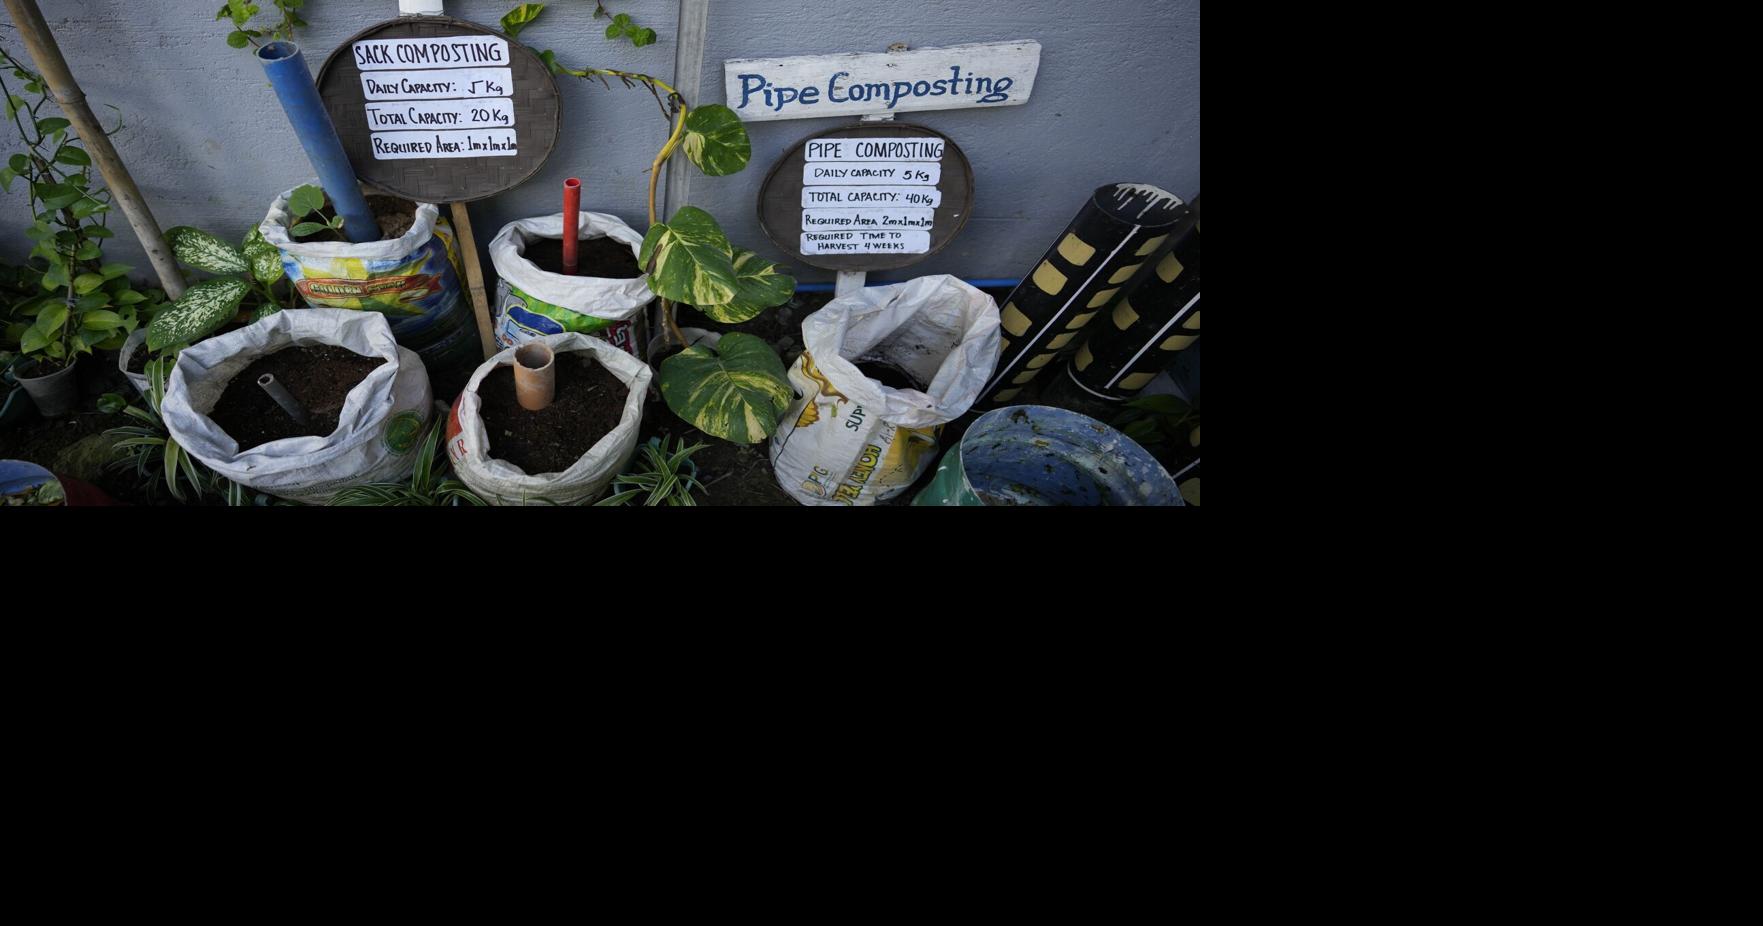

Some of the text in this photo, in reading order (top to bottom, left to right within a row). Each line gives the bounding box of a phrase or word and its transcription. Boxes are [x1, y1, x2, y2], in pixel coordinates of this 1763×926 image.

[355, 43, 502, 65] SACK COMPOSTING
[366, 79, 399, 94] DAILY
[486, 80, 503, 95] Kg
[738, 65, 1013, 112] Pipe Composting
[367, 108, 407, 125] TOTAL
[471, 108, 490, 122] 20
[492, 109, 509, 125] Kg
[373, 137, 432, 154] REQUIRED
[436, 135, 464, 153] AREA:
[808, 142, 943, 159] PIPE COMPOSTING
[814, 168, 930, 182] DAILY CAPACITY 5 Kg
[808, 192, 842, 202] TOTAL
[905, 193, 920, 204] 40
[921, 193, 934, 206] Kg
[805, 214, 851, 226] REQUIRED
[853, 214, 878, 226] AREA
[806, 232, 902, 242] REQUIRED TIME TO
[818, 242, 905, 251] HARVEST 4 WEEKS
